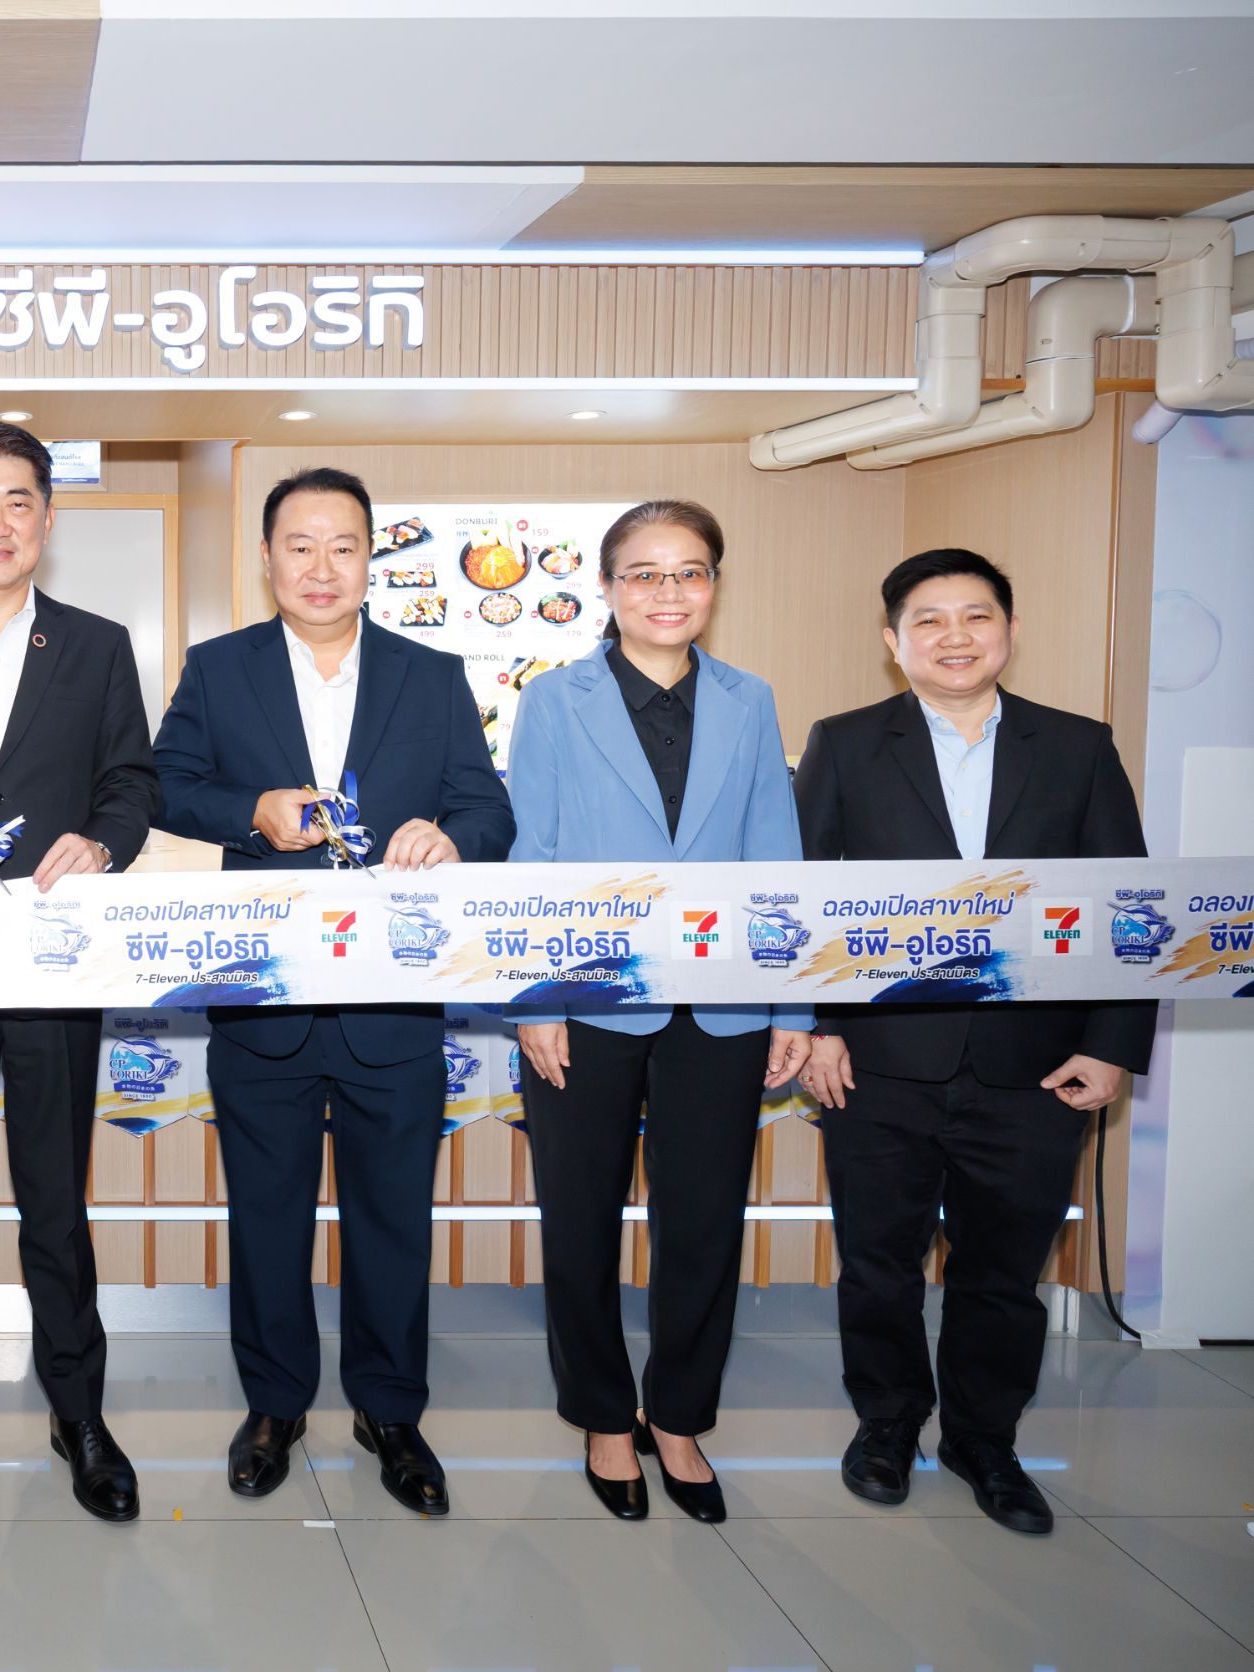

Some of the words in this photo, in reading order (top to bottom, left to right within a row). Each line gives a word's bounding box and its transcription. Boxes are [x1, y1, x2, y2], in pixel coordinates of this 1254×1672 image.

[416, 562, 435, 570] 299
[104, 897, 291, 921] ฉลองเปิดสาขาใหม่
[463, 895, 652, 918] ฉลองเปิดสาขาใหม่
[823, 892, 1015, 916] ฉลองเปิดสาขาใหม่
[126, 931, 269, 969] ซีพี-อูโอริกิ
[485, 929, 631, 966] ซีพี-อูโอริกิ
[846, 927, 991, 965] ซีพี-อูโอริกิ
[136, 973, 188, 984] 7-Eleven
[191, 971, 257, 984] ประสานมิตร
[496, 970, 548, 981] 7-Eleven
[551, 969, 619, 981] ประสานมิตร
[855, 968, 908, 979] 7-Eleven
[911, 967, 979, 979] ประสานมิตร
[109, 1060, 125, 1068] CP
[110, 1070, 147, 1079] UORIKI
